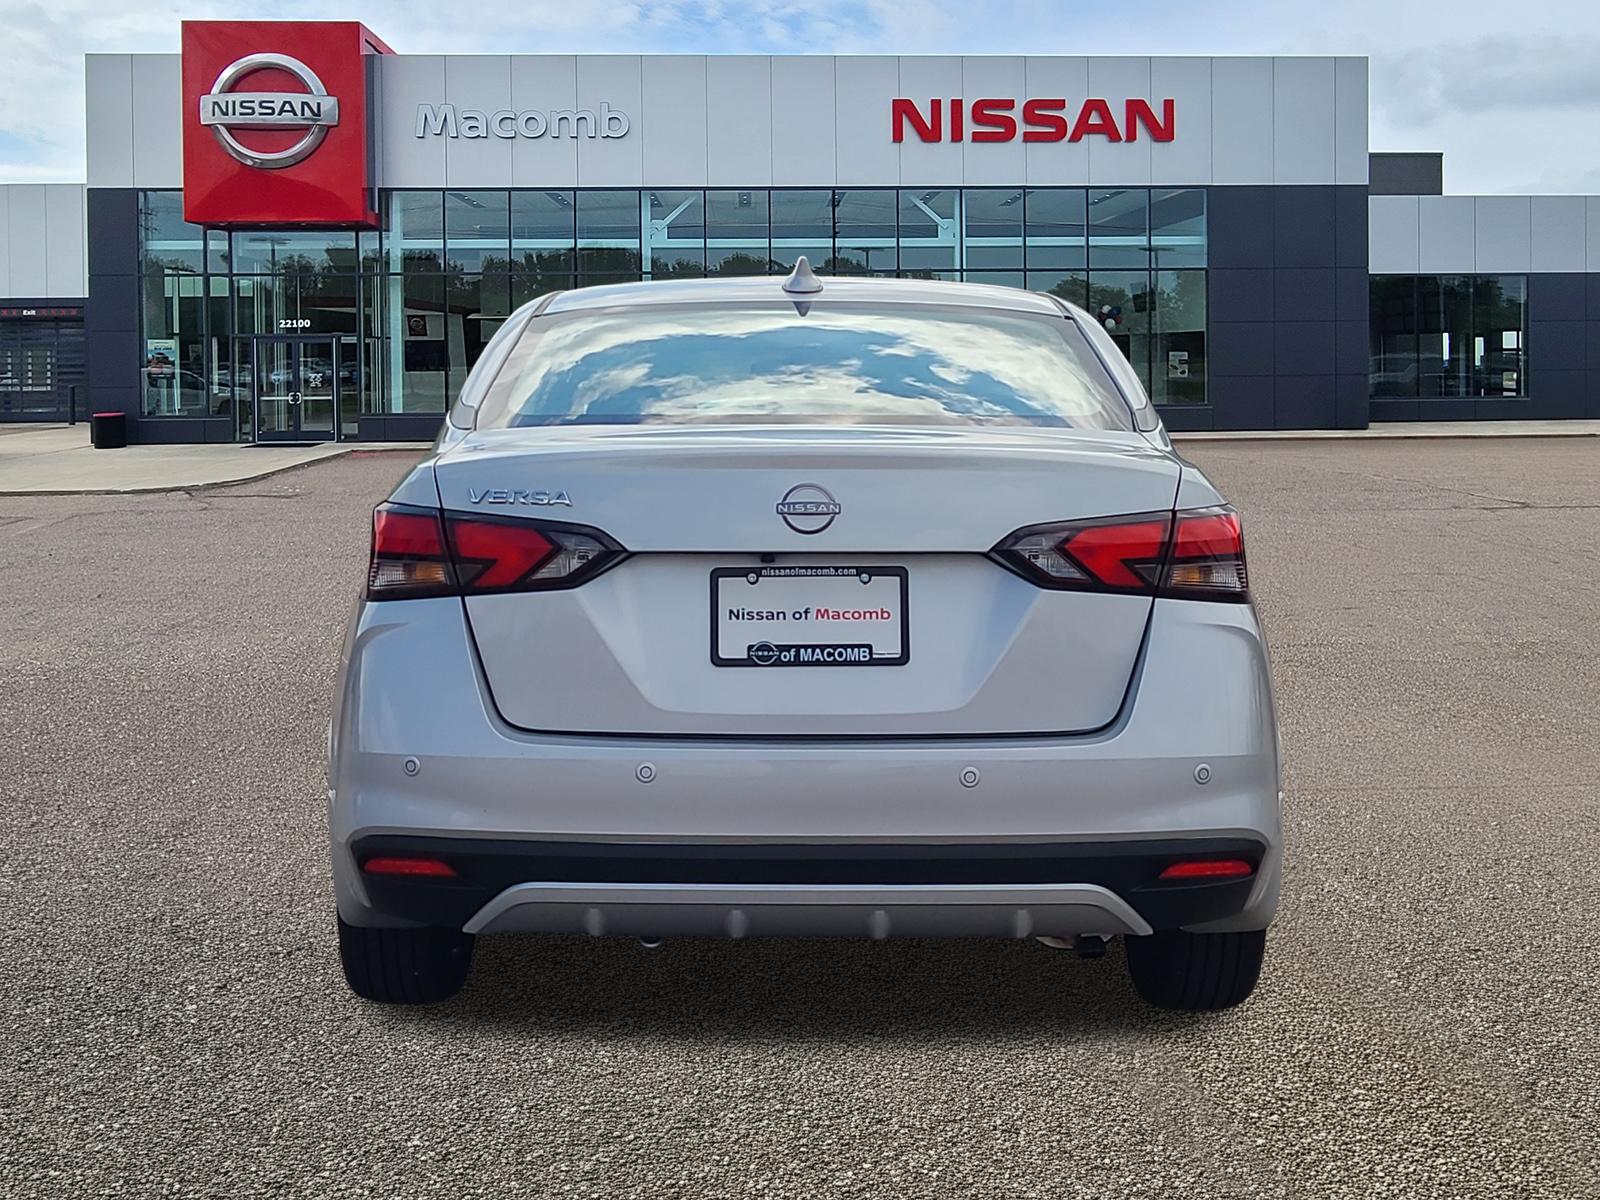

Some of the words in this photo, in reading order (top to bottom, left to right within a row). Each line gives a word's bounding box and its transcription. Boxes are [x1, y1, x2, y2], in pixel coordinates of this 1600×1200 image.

[212, 100, 322, 118] NISSAN
[415, 102, 630, 139] Macomb
[892, 98, 1175, 143] NISSAN
[279, 319, 311, 328] 22100
[468, 488, 573, 507] VERSA
[778, 503, 840, 513] NISSAN
[761, 567, 857, 576] nissanofmacomb.com
[728, 608, 786, 621] Nissan
[792, 608, 811, 621] of
[815, 607, 891, 620] Macomb
[780, 647, 796, 662] of
[800, 648, 871, 661] MACOMB
